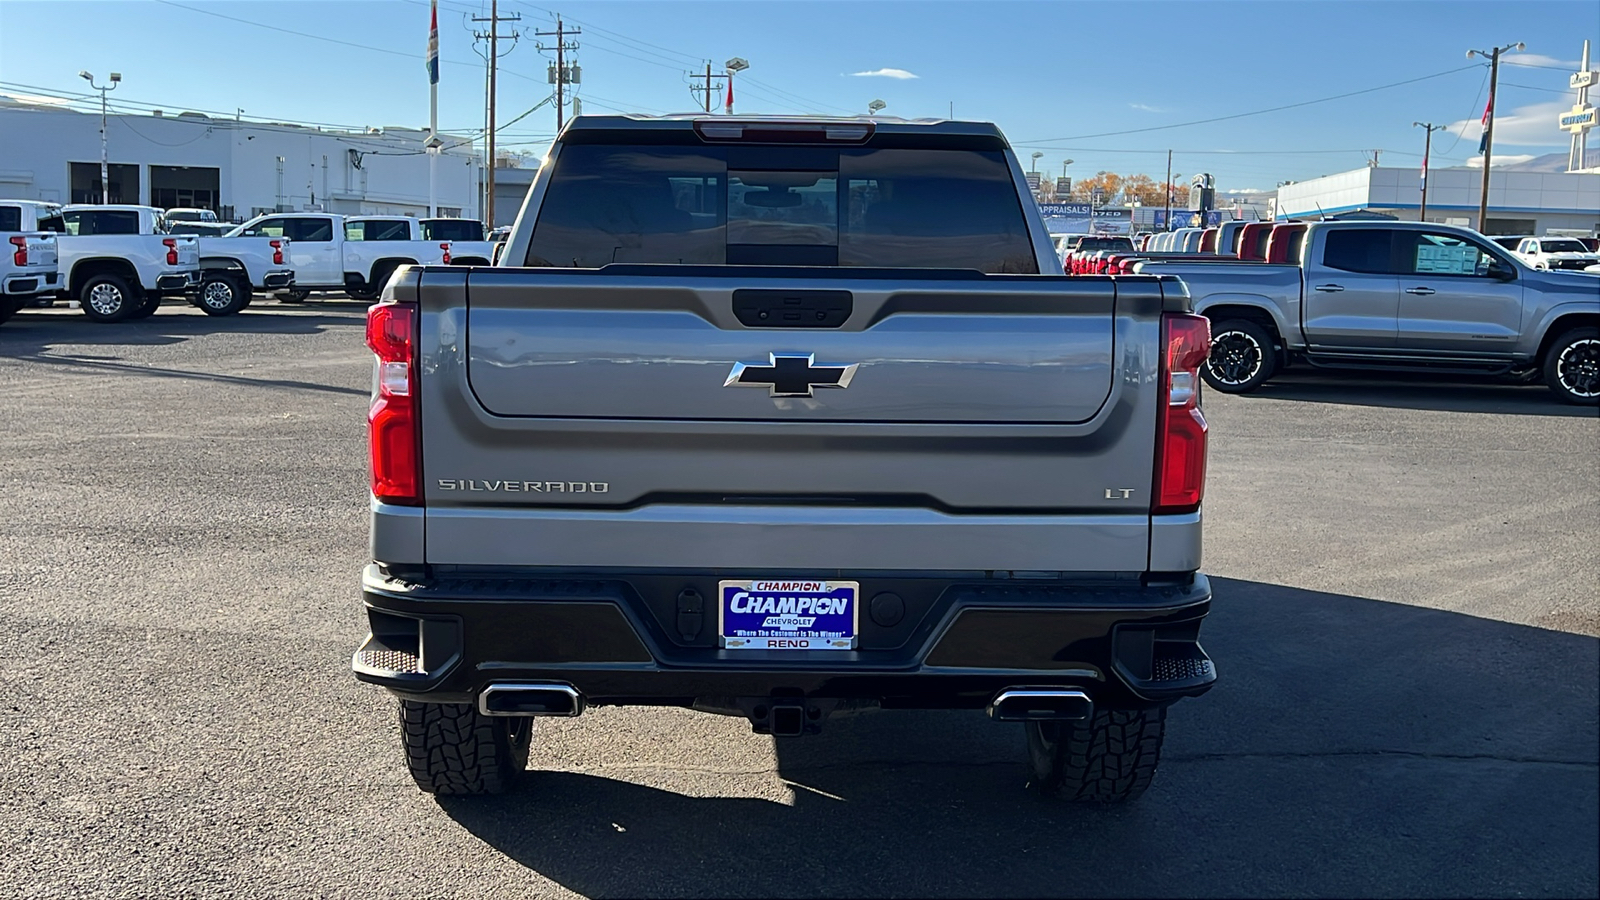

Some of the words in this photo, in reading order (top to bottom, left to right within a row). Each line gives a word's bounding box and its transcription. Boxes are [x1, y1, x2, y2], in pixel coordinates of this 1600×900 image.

[438, 479, 609, 493] SILVERADO
[1105, 488, 1135, 499] LT
[756, 582, 821, 591] CHAMPION
[766, 618, 812, 626] CHEVROLET
[767, 640, 809, 648] RENO
